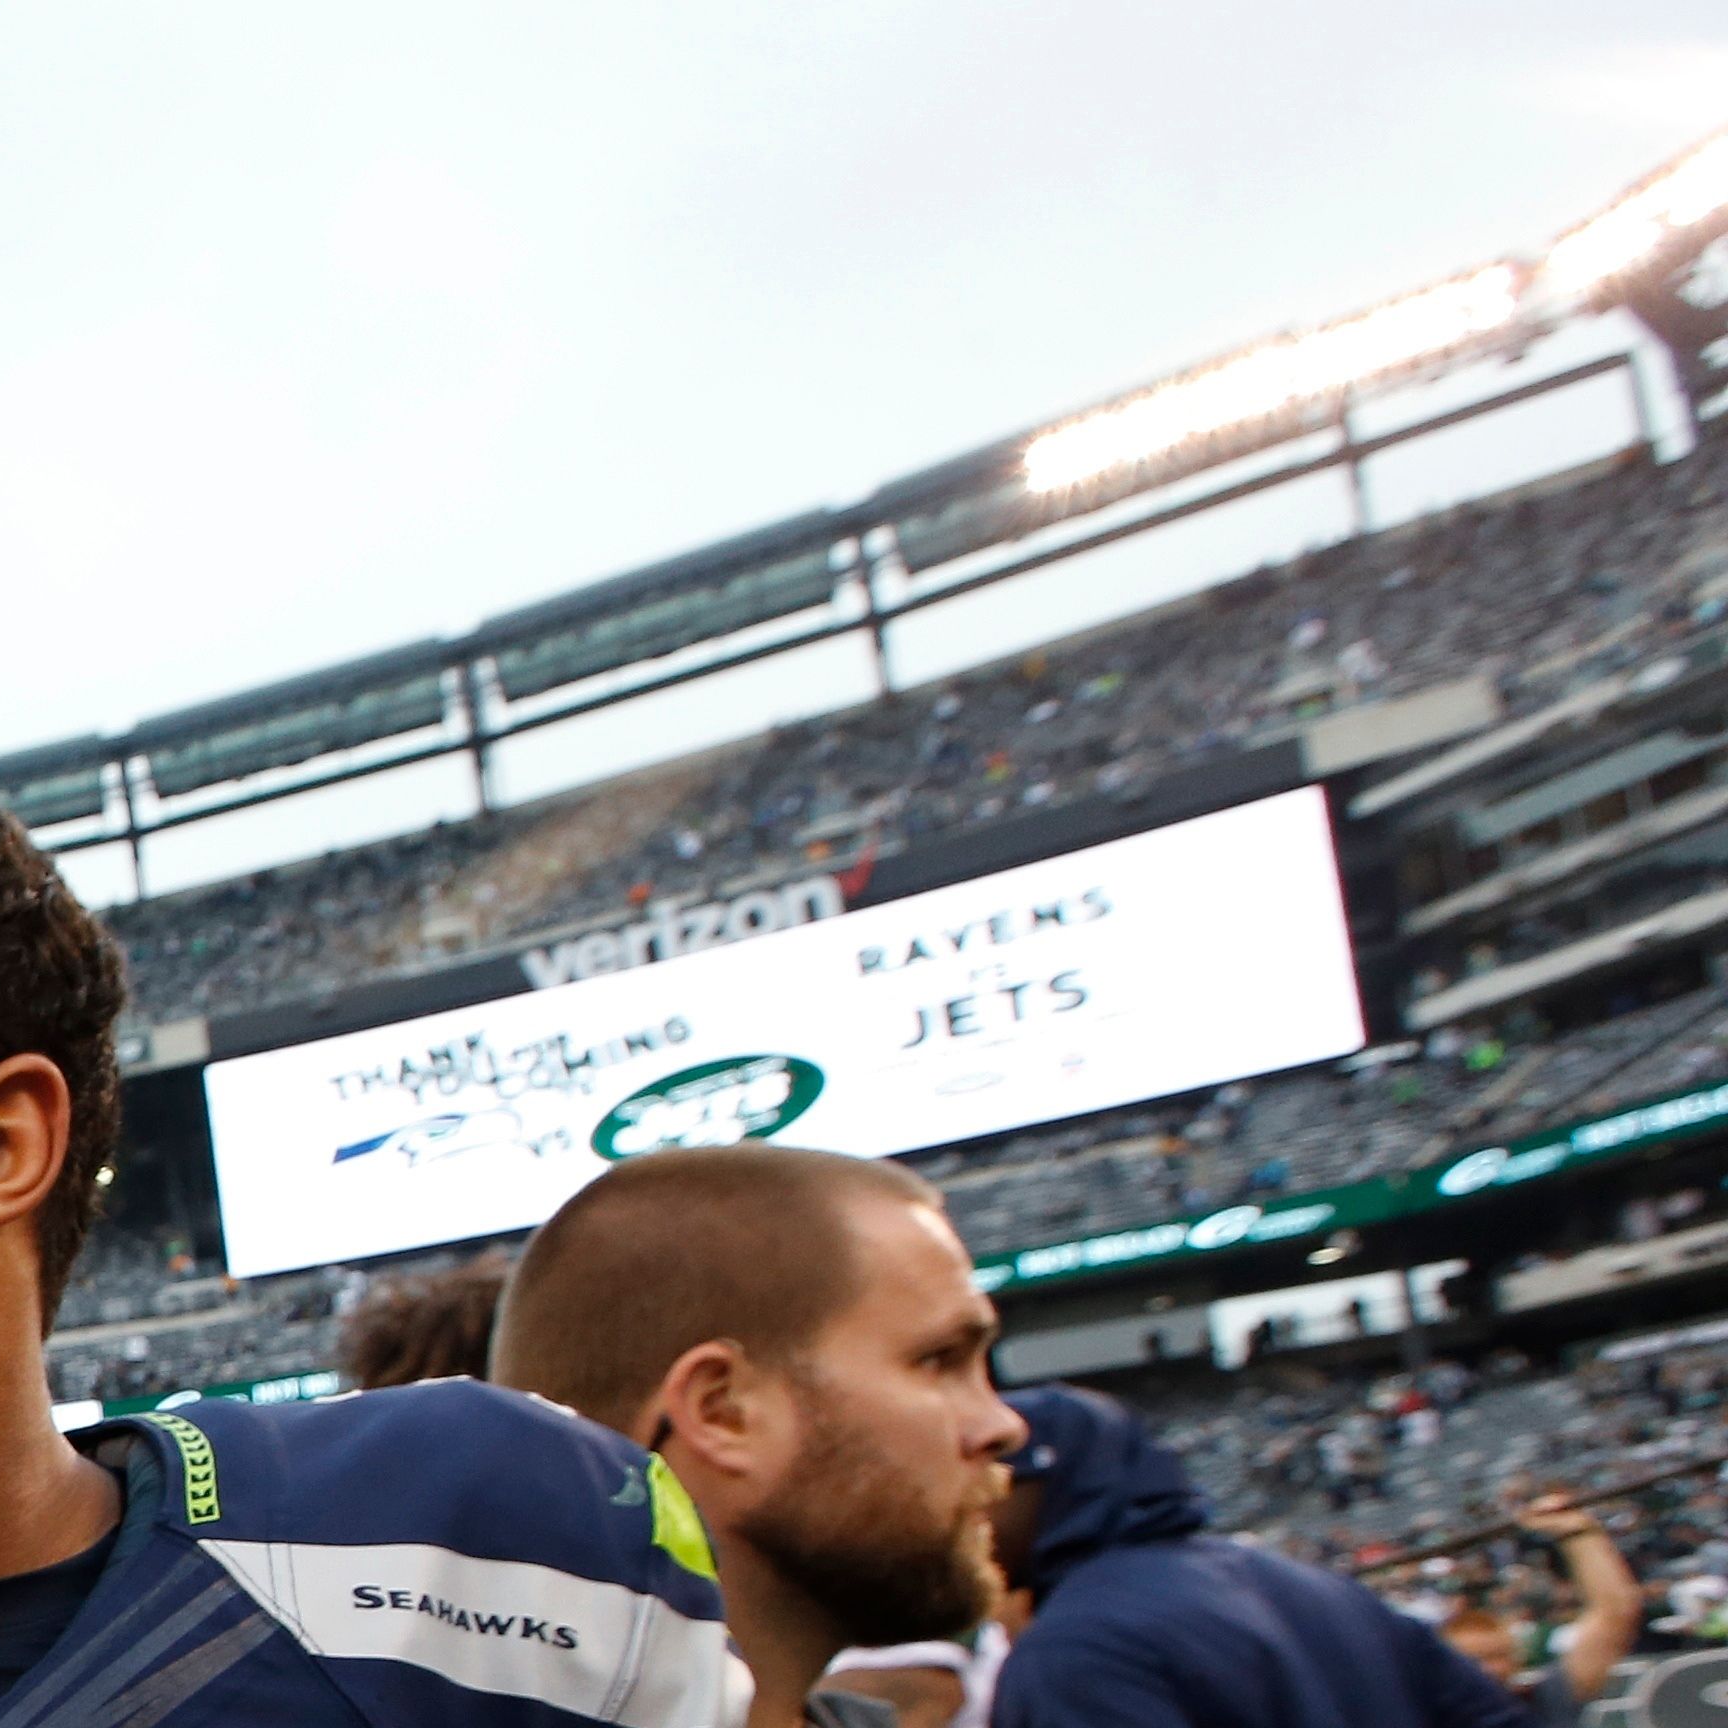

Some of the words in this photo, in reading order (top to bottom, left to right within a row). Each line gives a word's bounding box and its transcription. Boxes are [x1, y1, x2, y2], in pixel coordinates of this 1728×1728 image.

[520, 876, 843, 992] verizon
[857, 886, 1114, 976] RAVENS
[901, 968, 1088, 1050] JETS
[352, 1584, 578, 1649] SEAHAWKS
